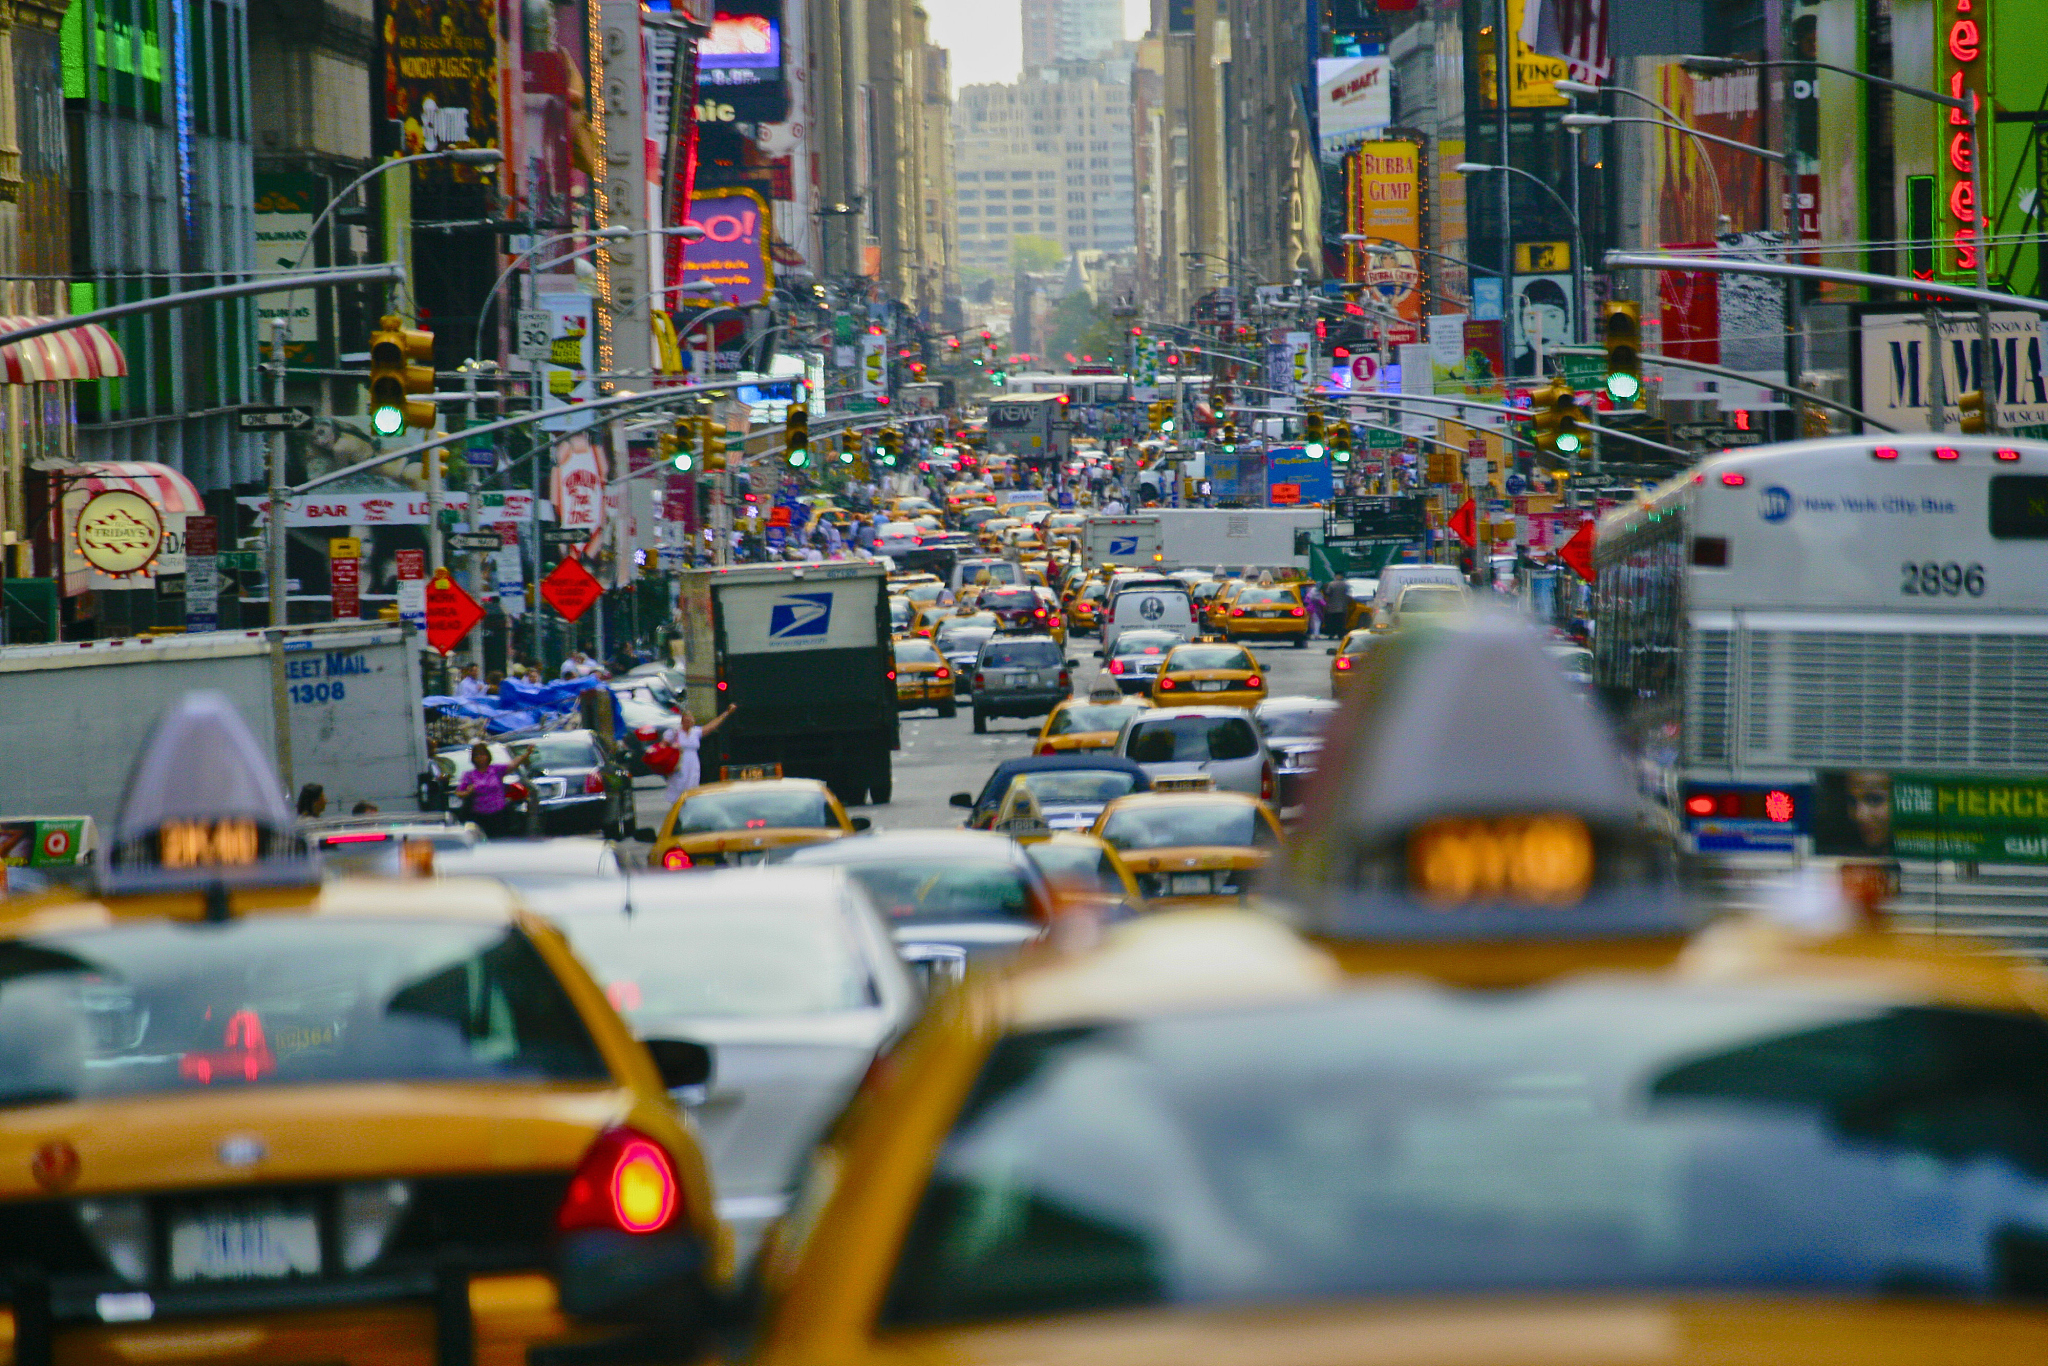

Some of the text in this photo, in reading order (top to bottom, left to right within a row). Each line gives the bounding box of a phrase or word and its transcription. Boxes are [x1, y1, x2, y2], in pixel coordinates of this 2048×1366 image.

[400, 57, 436, 78] MONDAY
[1517, 63, 1562, 90] KING
[1365, 154, 1414, 175] BUBBA
[1369, 180, 1412, 201] GUMP
[522, 330, 549, 346] 30
[1888, 337, 2048, 408] MMMA
[247, 413, 304, 424] ONE WAY
[306, 504, 348, 518] BAR
[1883, 496, 1914, 516] City
[1920, 496, 1956, 514] Bus
[94, 528, 147, 538] FRIDAY'S
[1901, 560, 1986, 598] 2896
[326, 652, 371, 677] MAIL
[289, 681, 346, 705] 1308
